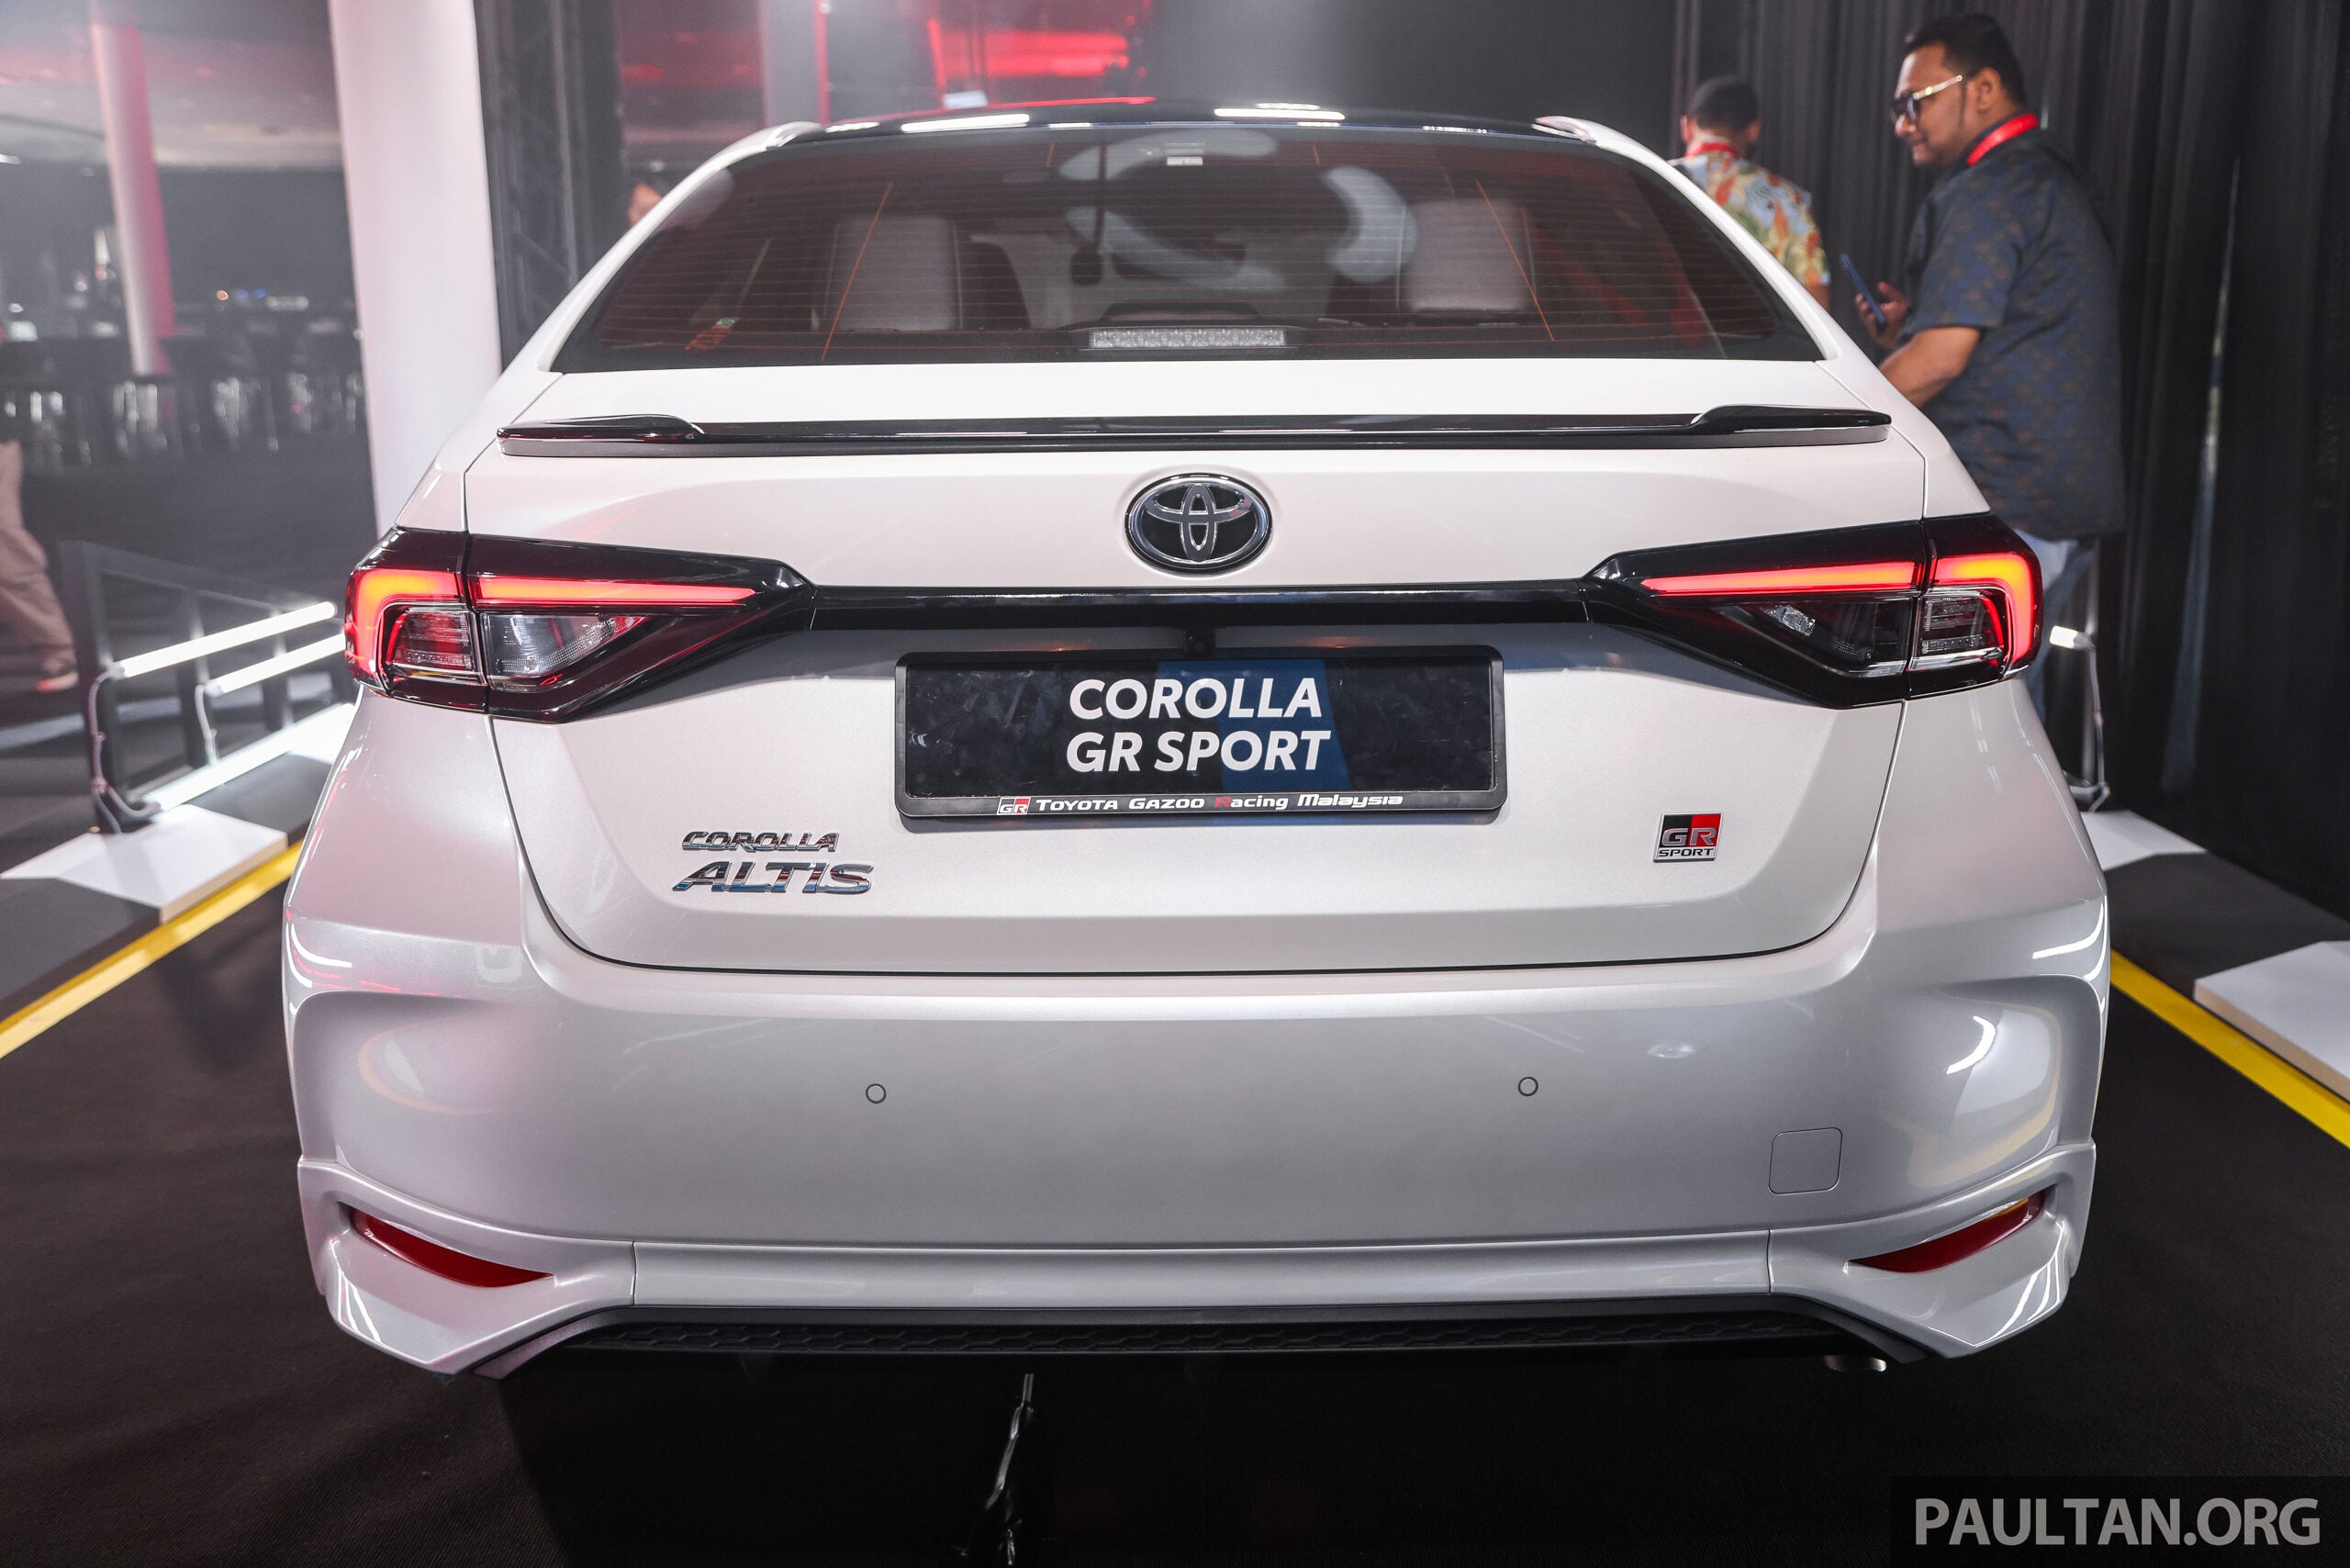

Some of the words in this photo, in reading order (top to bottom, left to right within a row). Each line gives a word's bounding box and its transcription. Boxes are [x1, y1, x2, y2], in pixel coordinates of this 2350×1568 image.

[1069, 678, 1322, 720] COROLLA
[1066, 731, 1141, 772] GR
[1155, 730, 1331, 772] SPORT
[1129, 797, 1205, 810] GAZOO
[1214, 795, 1289, 811] Racing
[1298, 793, 1404, 809] Malaysia
[682, 831, 840, 853] COROLLA
[1662, 827, 1717, 846] GR
[1658, 848, 1715, 857] SPORT
[672, 861, 874, 895] ALTIS
